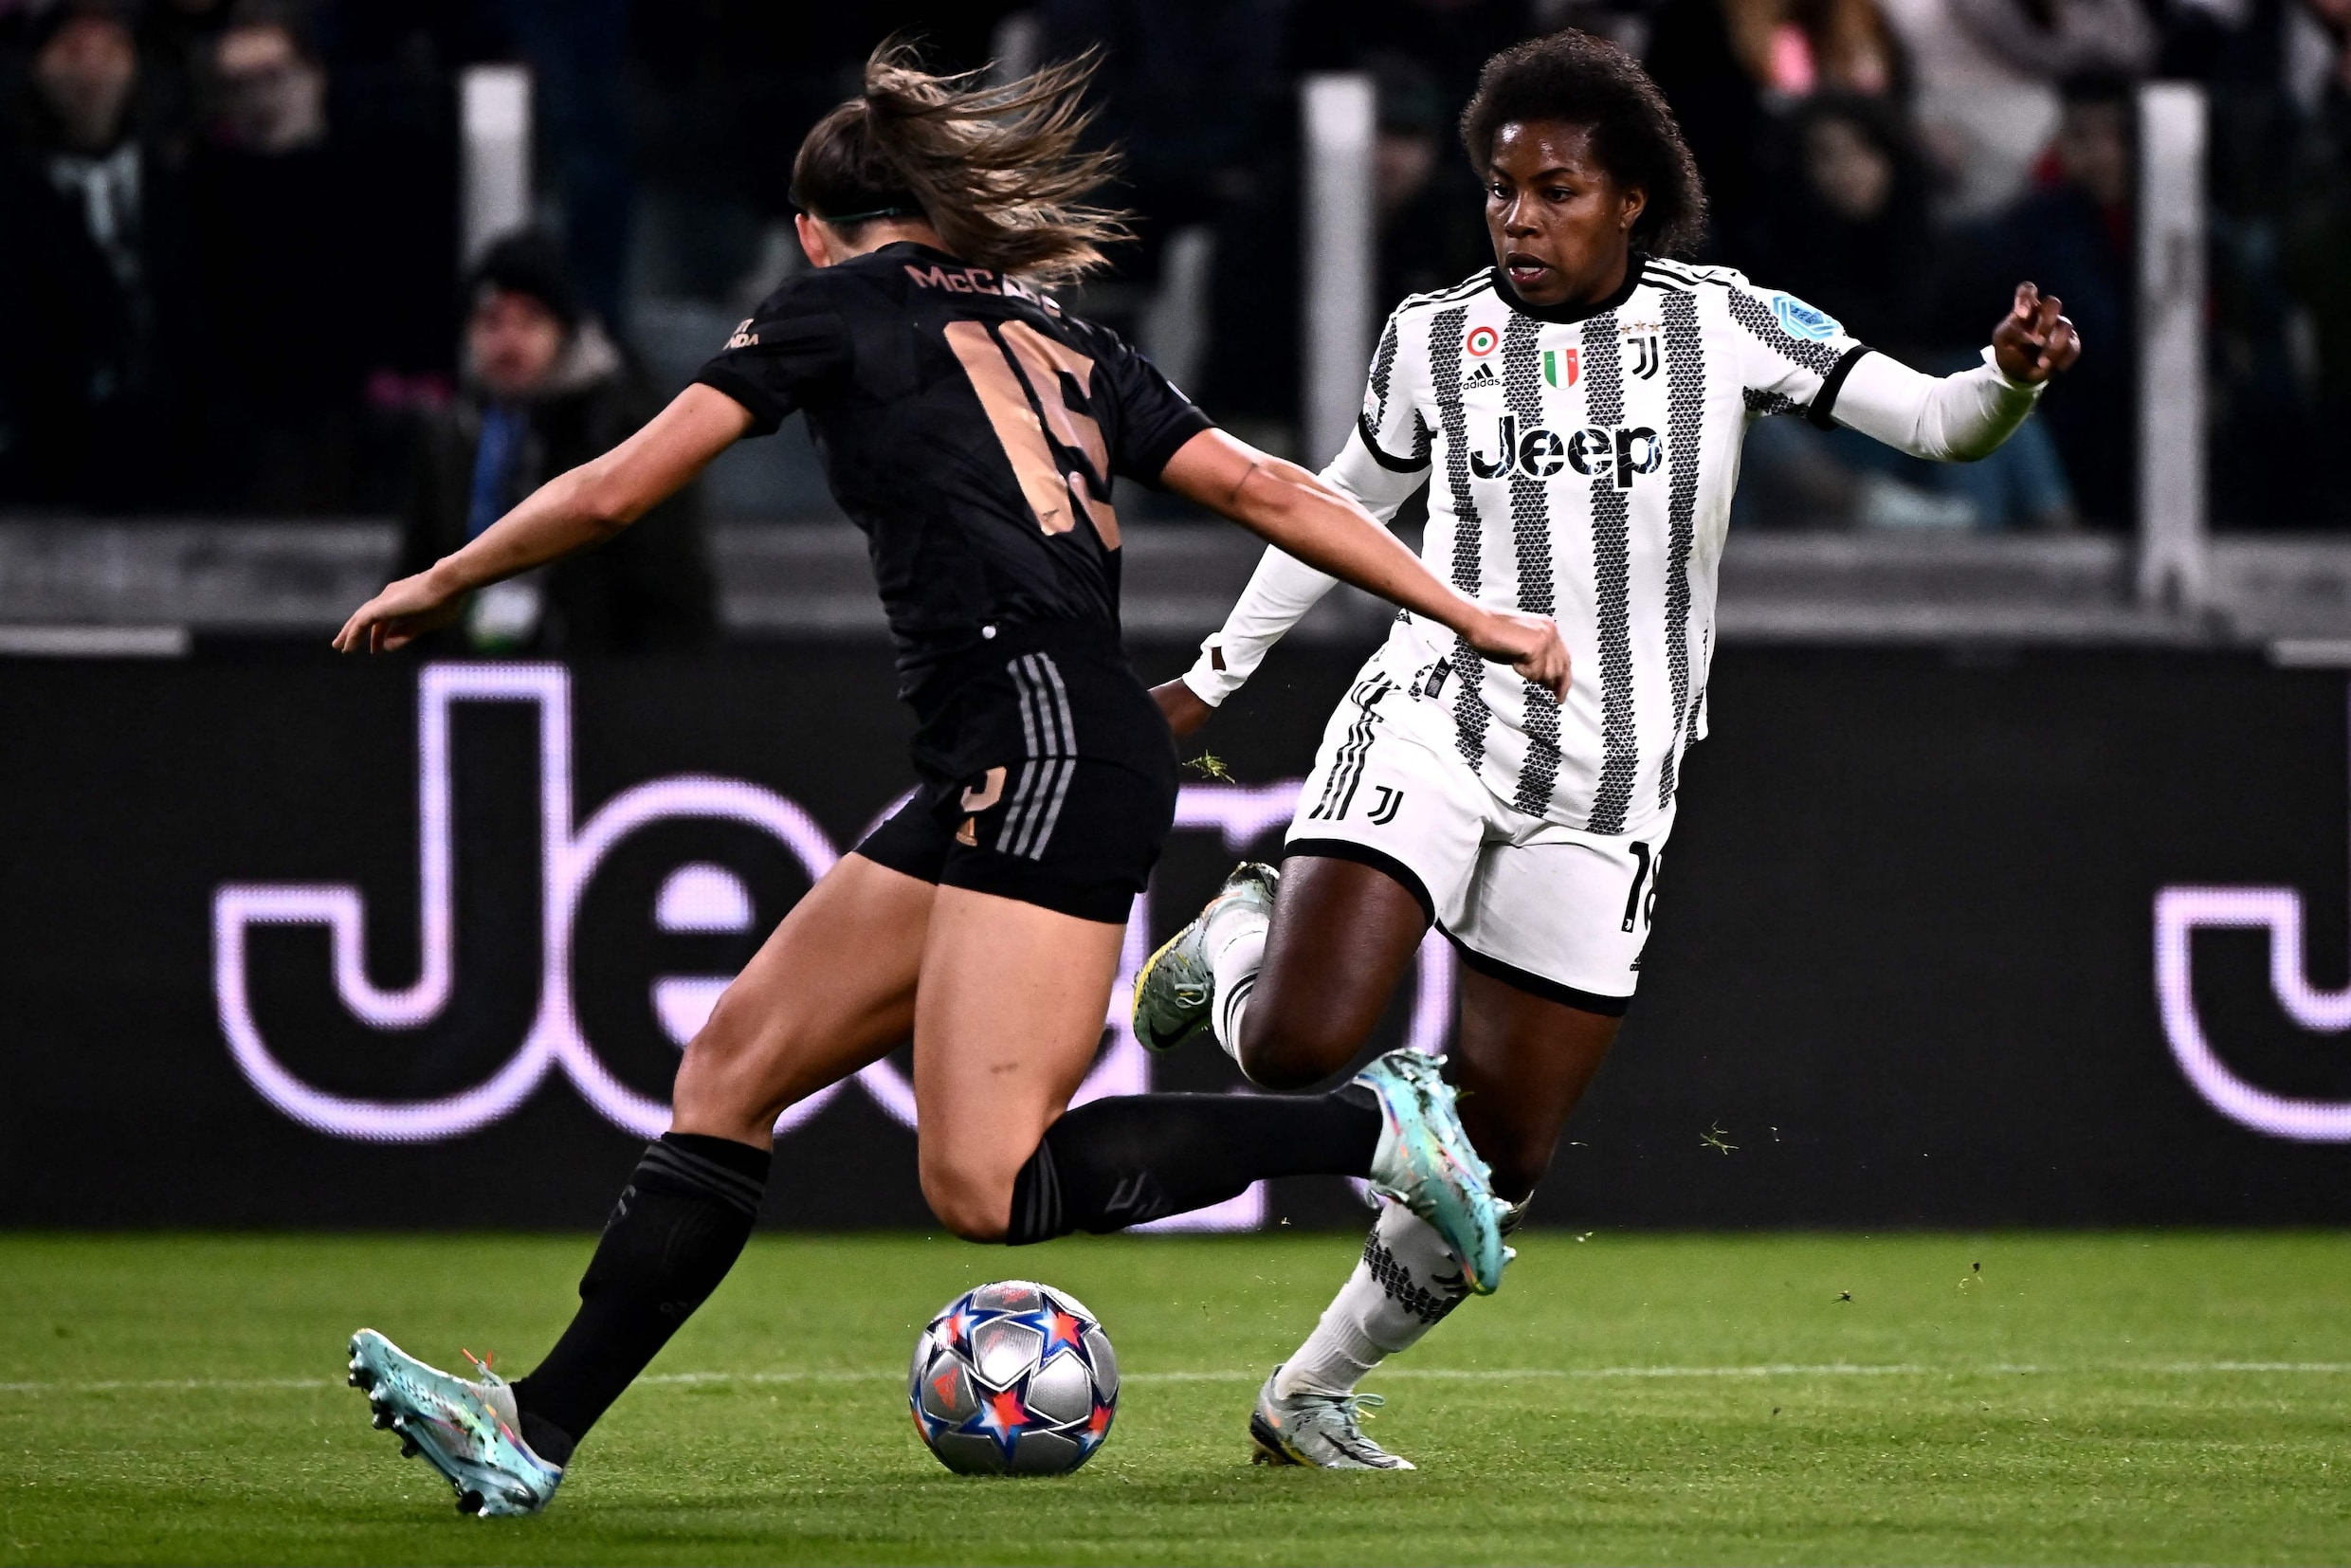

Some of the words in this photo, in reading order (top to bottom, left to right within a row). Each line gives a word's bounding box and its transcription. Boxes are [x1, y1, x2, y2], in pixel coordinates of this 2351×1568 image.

[1463, 377, 1501, 391] adidas
[1470, 415, 1663, 488] Jeep
[212, 664, 1457, 1232] Je
